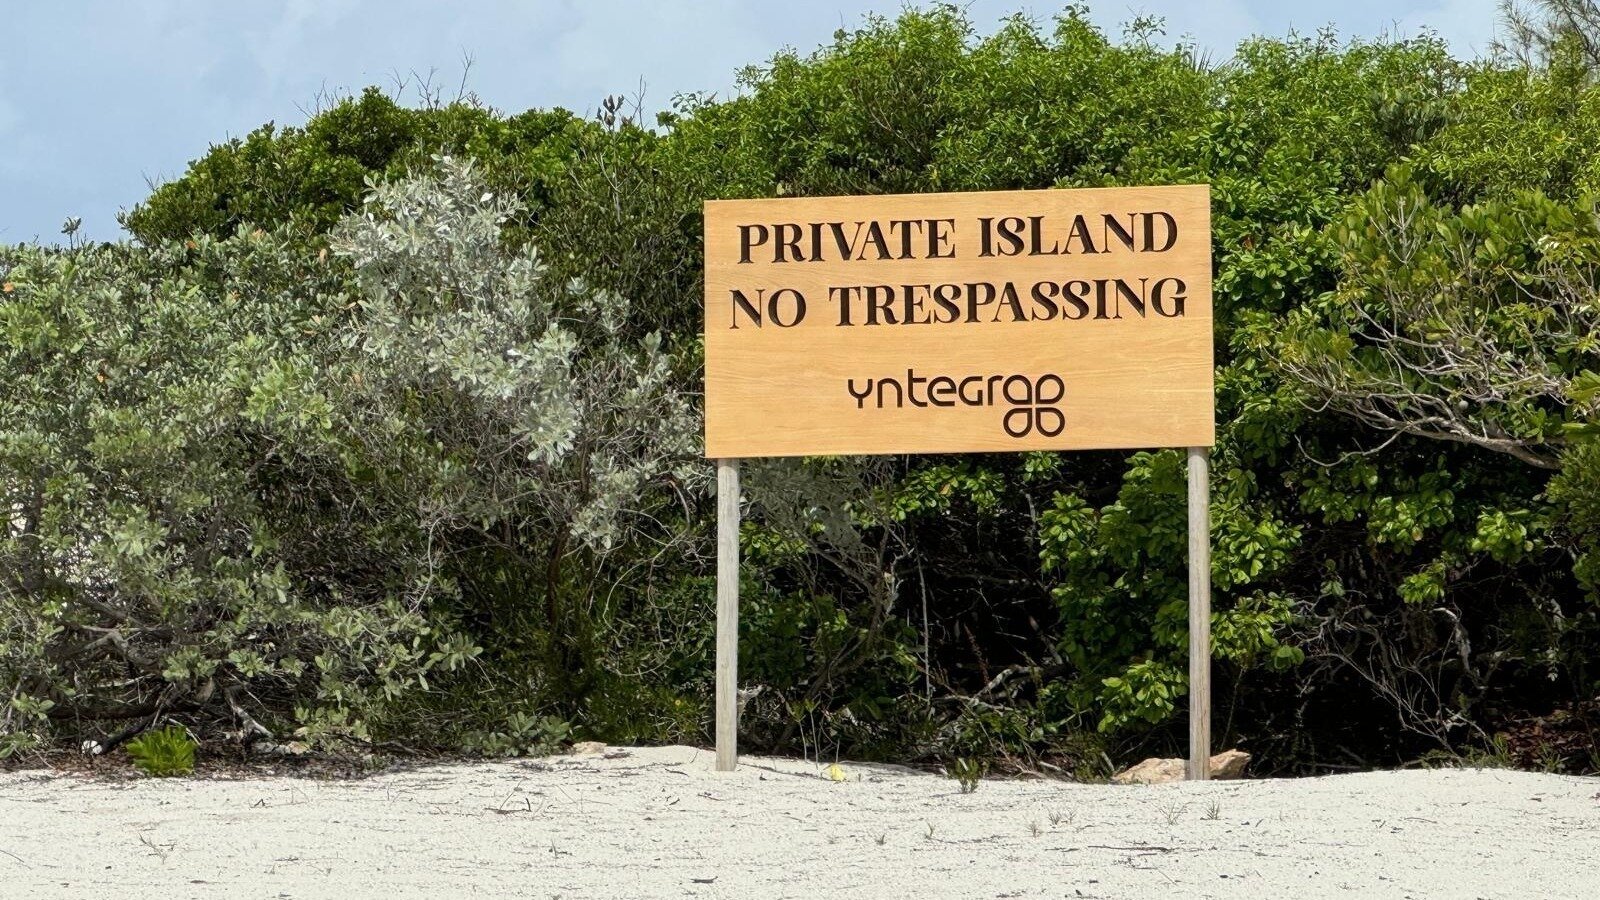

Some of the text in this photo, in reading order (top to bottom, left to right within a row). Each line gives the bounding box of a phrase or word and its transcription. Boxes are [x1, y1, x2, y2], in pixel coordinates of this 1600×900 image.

[736, 211, 1178, 265] PRIVATE ISLAND
[729, 277, 1188, 330] NO TRESPASSING
